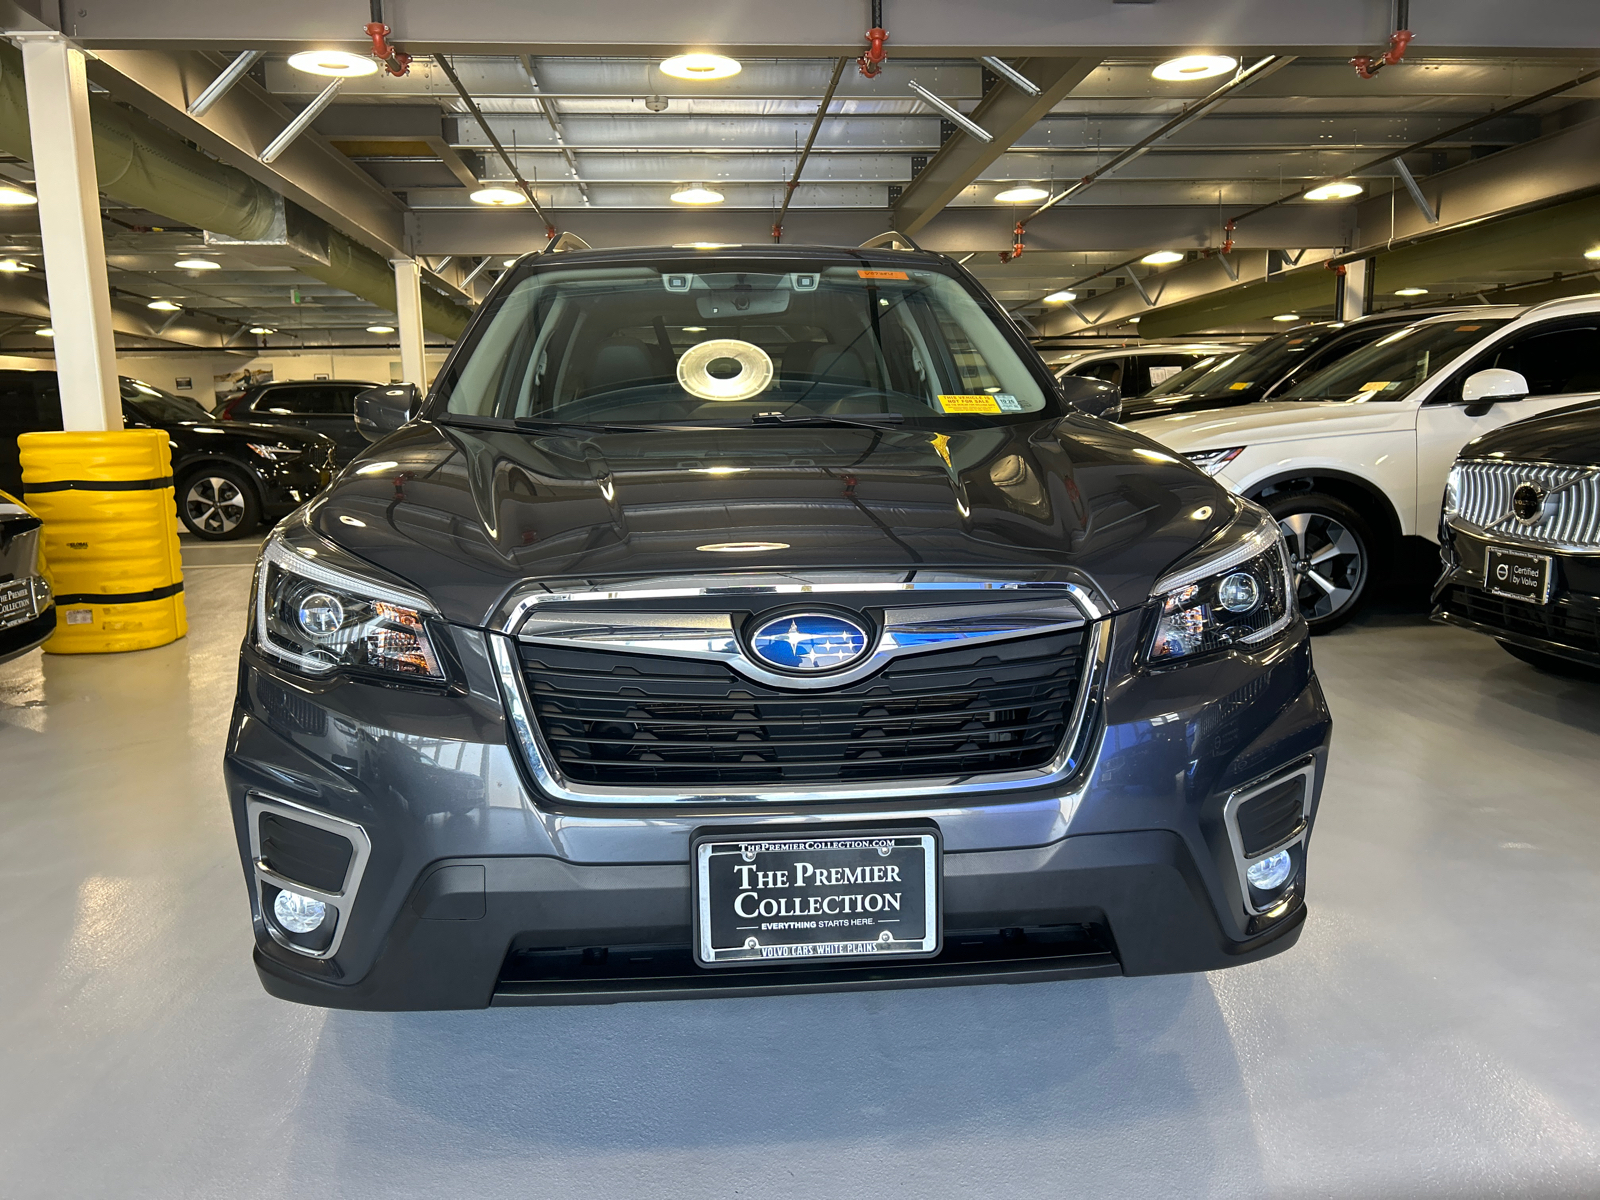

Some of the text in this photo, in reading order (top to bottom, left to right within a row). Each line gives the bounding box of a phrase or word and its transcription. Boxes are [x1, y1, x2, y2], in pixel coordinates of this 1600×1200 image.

[1513, 565, 1540, 578] Certified
[1512, 574, 1538, 588] by Volvo
[734, 862, 902, 890] THE PREMIER
[734, 890, 902, 918] COLLECTION
[761, 918, 876, 930] EVERYTHING STARTS HERE.
[761, 942, 878, 957] VOLVO CARS WHITE PLAINS
